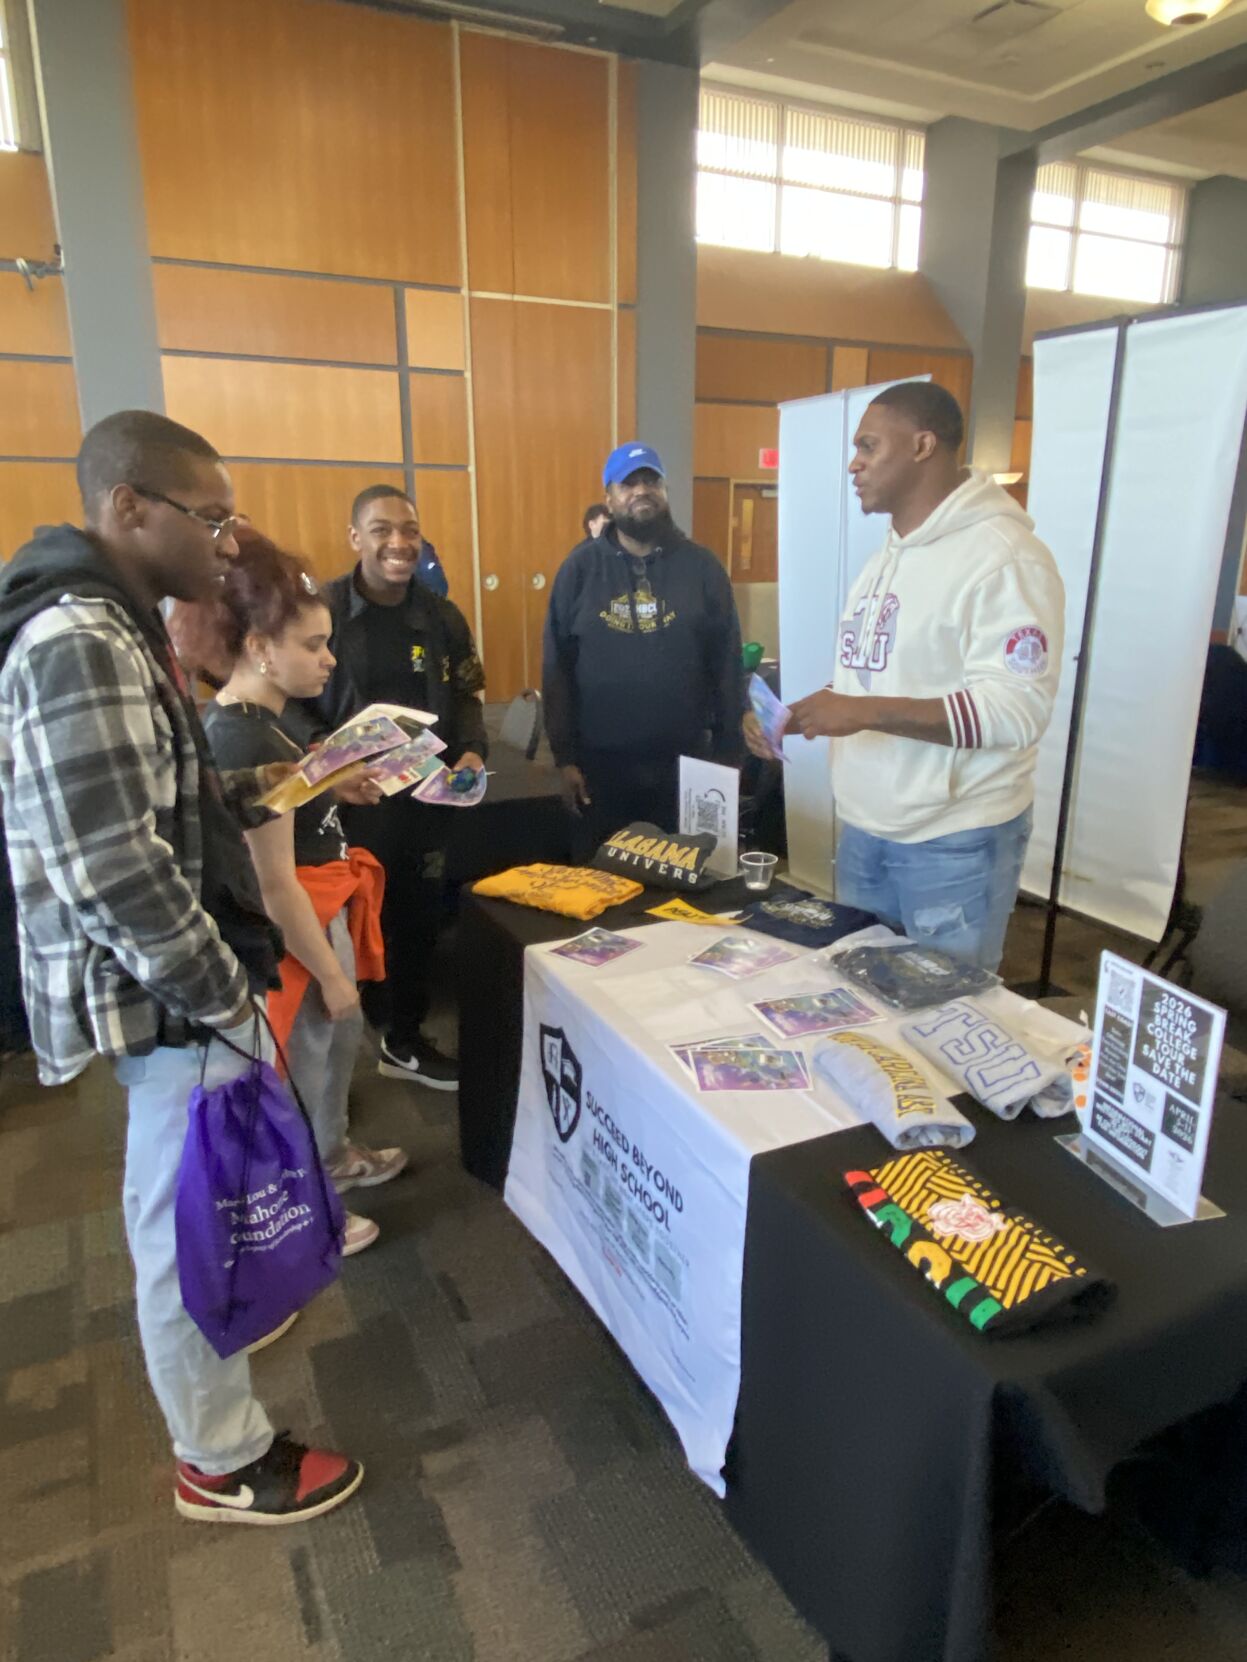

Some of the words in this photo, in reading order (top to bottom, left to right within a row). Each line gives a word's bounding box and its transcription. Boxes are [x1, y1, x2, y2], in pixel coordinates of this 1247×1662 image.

[607, 847, 698, 884] UNIVERS
[1153, 1001, 1197, 1033] SPRING
[1162, 993, 1192, 1018] 2026
[1147, 1023, 1198, 1060] COLLEGE
[1154, 1015, 1193, 1044] BREAK
[911, 1000, 1042, 1104] TSU
[1142, 1044, 1172, 1070] SAVE
[1174, 1063, 1197, 1085] THE
[1156, 1039, 1185, 1066] TOUR
[1152, 1062, 1181, 1089] DATE
[586, 1090, 630, 1154] SUCCEED
[632, 1144, 683, 1213] BEYOND
[247, 1190, 267, 1204] Lou
[267, 1183, 278, 1194] &
[593, 1128, 618, 1172] HIGH
[621, 1162, 671, 1233] SCHOOL
